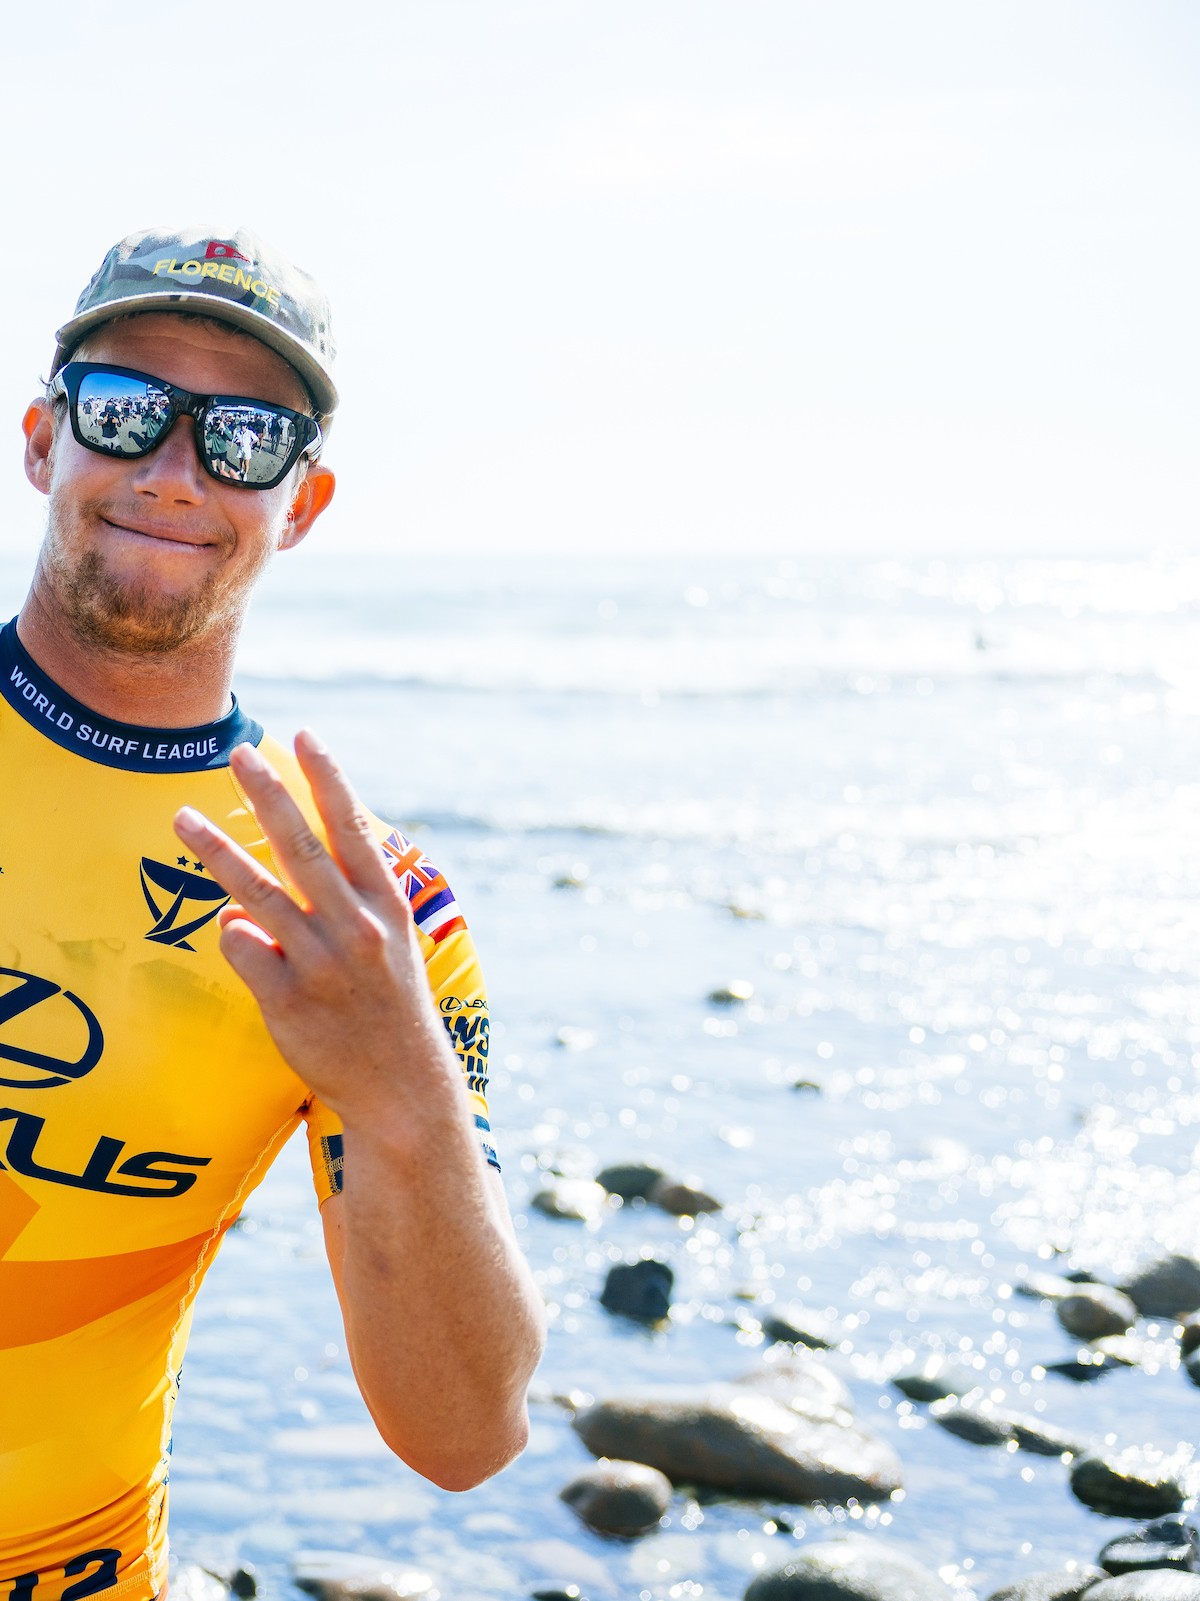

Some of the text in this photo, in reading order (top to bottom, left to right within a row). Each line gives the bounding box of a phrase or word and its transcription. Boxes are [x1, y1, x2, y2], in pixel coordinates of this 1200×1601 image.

[153, 258, 282, 308] FLORENCE
[9, 665, 219, 760] WORLD SURF LEAGUE
